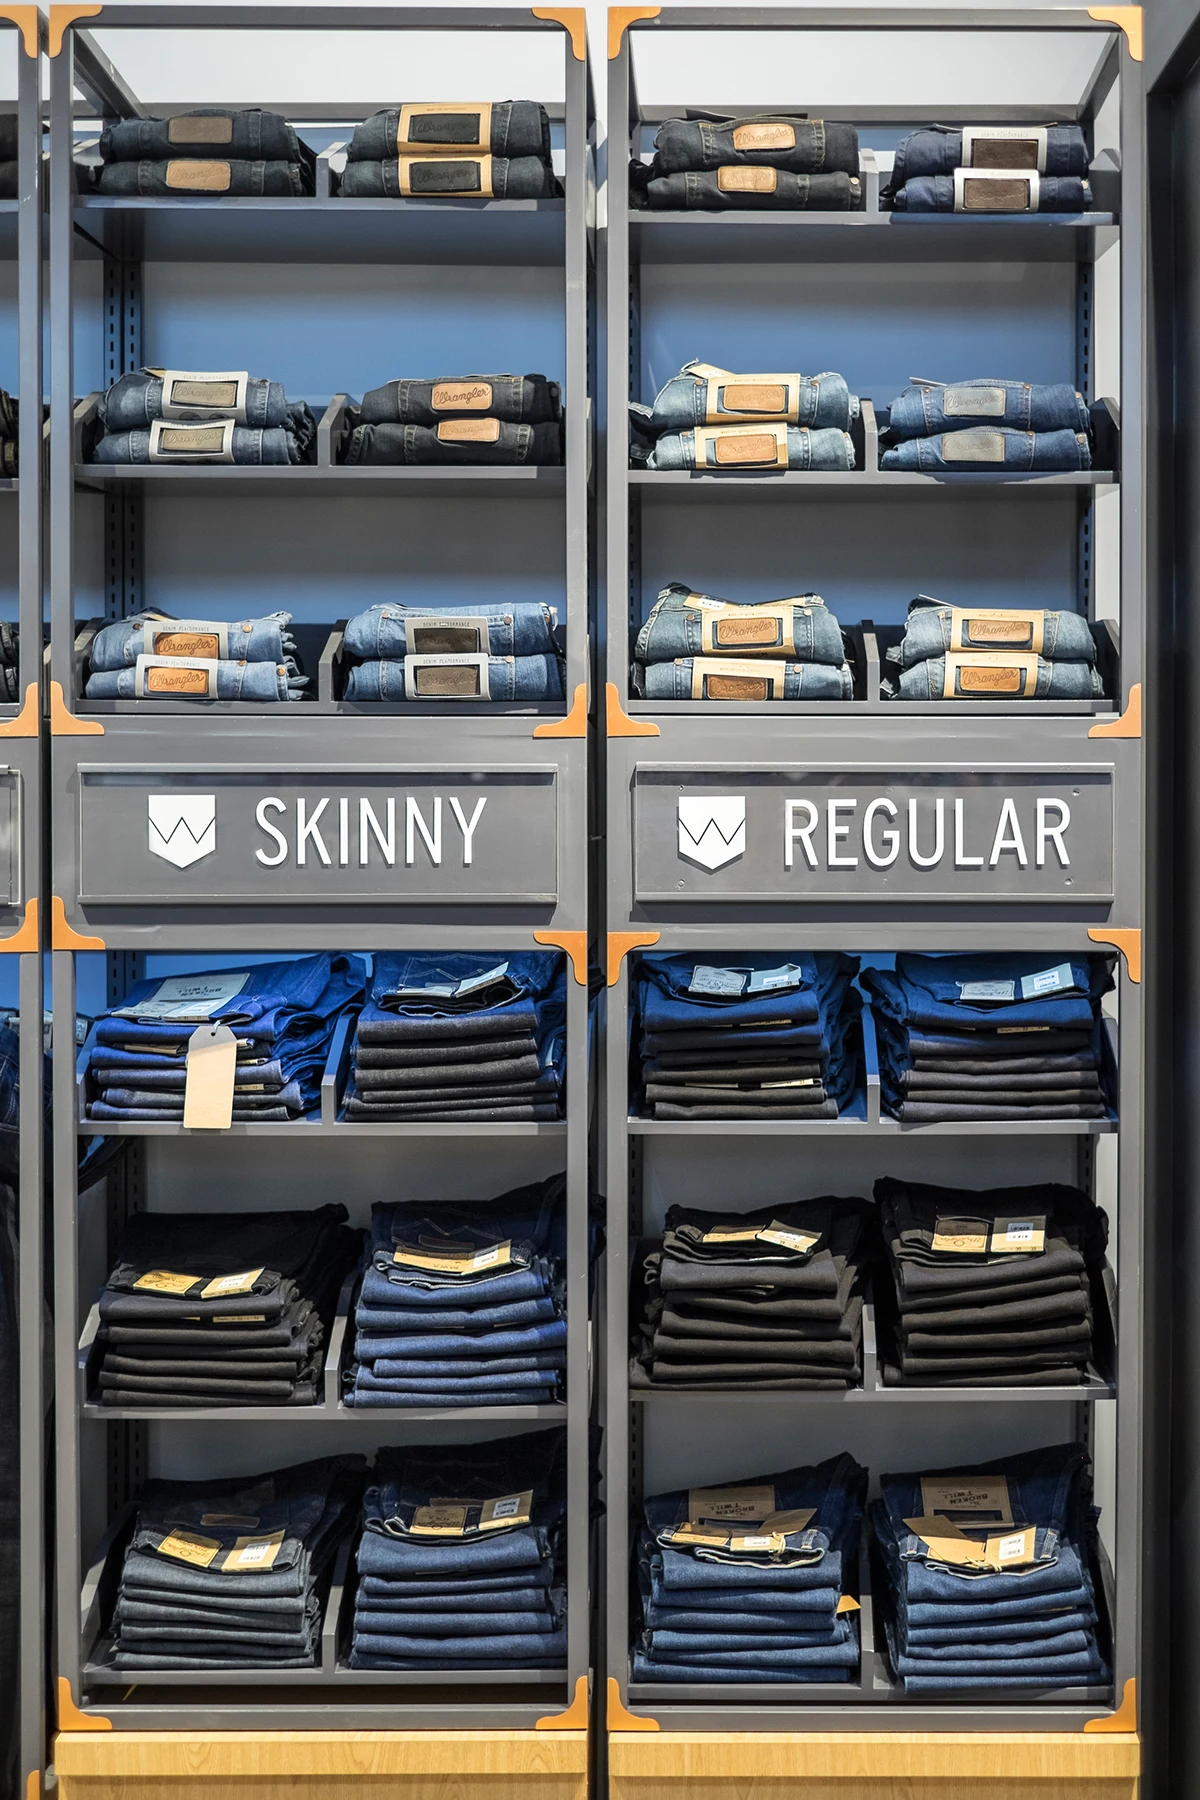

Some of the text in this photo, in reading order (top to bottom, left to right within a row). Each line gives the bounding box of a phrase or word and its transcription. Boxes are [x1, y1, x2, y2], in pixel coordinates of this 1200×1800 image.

[175, 386, 233, 402] Wrangler
[433, 386, 491, 406] Wrangler
[165, 430, 222, 446] Wrangler
[719, 620, 776, 639] Wrangler
[970, 621, 1028, 637] Wrangler
[158, 637, 215, 656] Wrangler
[151, 671, 205, 689] Wrangler
[962, 668, 1019, 687] Wrangler
[708, 678, 766, 697] Wrangler
[254, 796, 488, 867] SKINNY
[783, 797, 1071, 867] REGULAR
[942, 1490, 973, 1499] TWILL
[949, 1493, 989, 1505] BROKEN
[709, 1502, 741, 1511] TWILL
[716, 1505, 755, 1515] BROKEN
